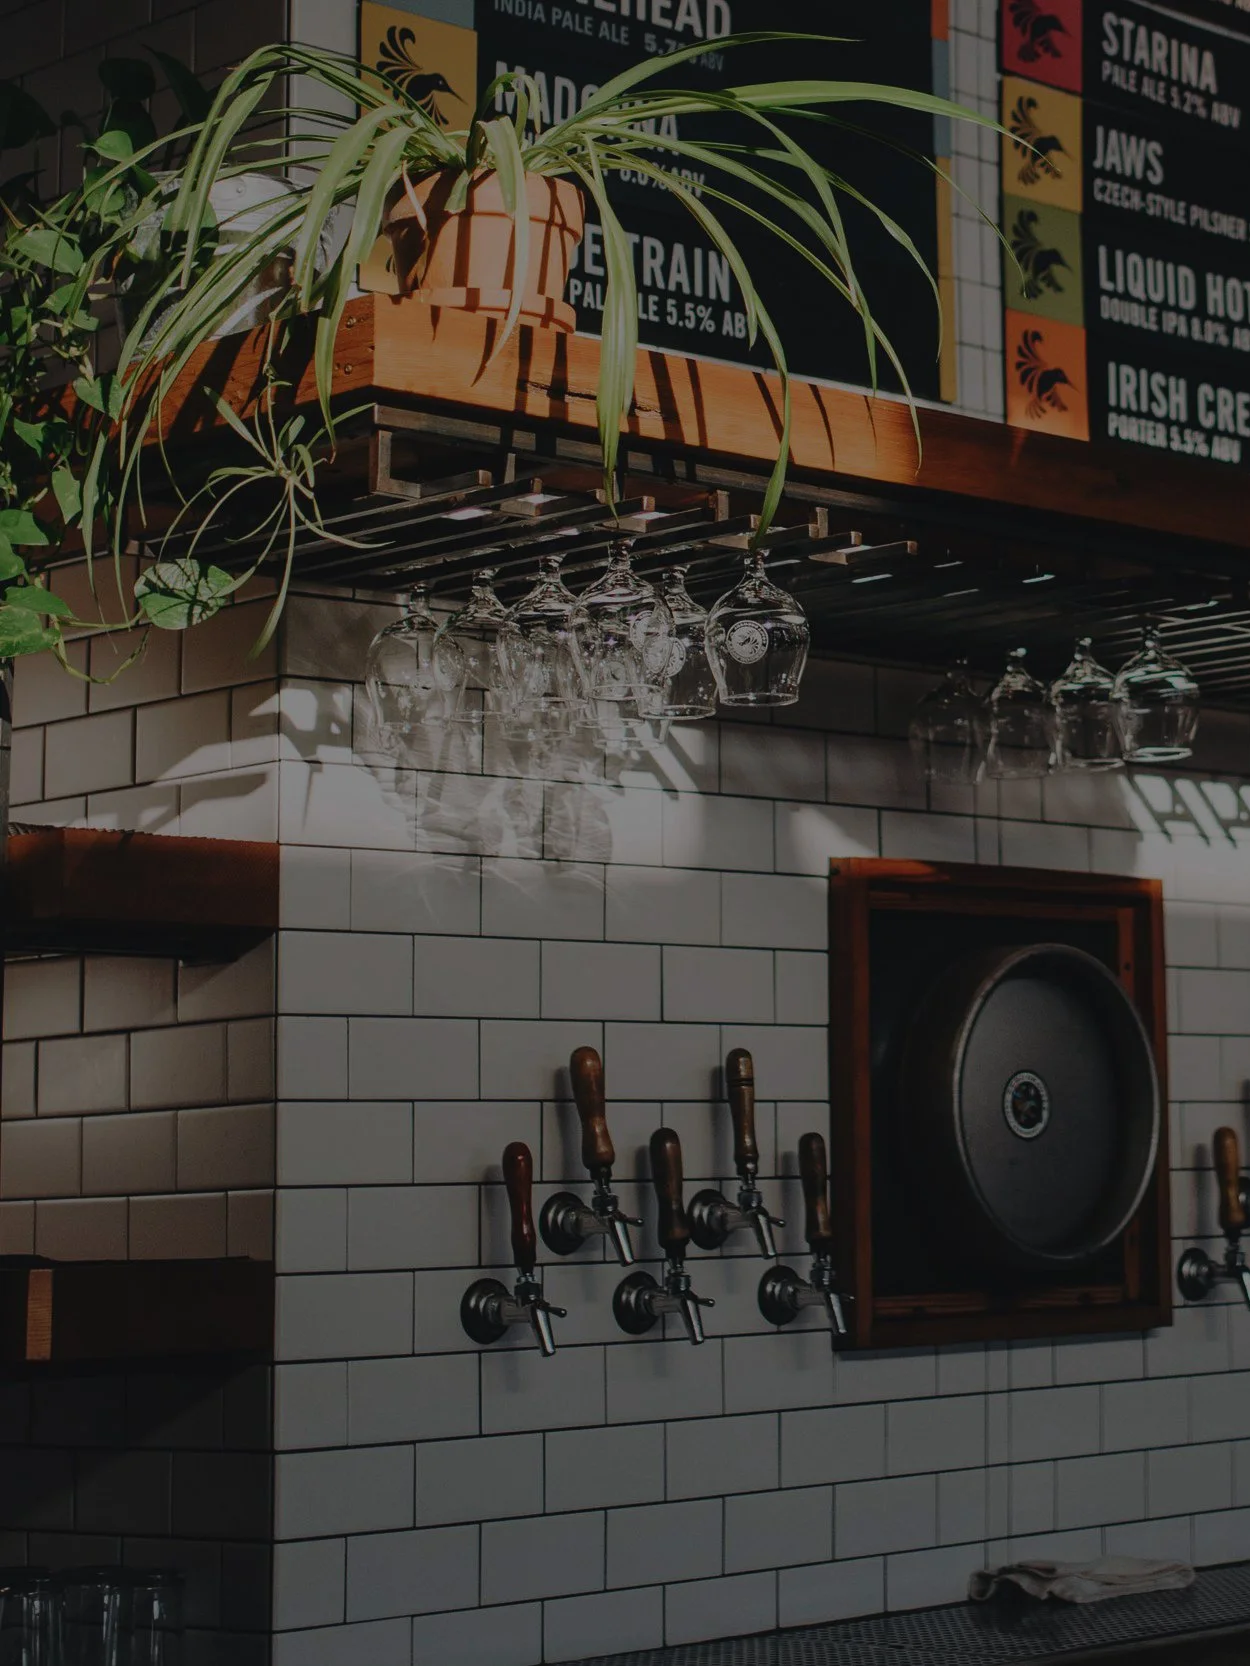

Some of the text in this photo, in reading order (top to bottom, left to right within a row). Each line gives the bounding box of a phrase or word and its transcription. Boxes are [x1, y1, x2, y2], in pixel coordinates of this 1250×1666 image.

[493, 0, 546, 24] INDIA
[551, 6, 593, 36] PALE
[598, 20, 631, 46] ALE
[1101, 11, 1218, 95] STARINA
[1101, 60, 1138, 94] PALE
[1141, 76, 1168, 106] ALE
[1211, 101, 1242, 129] ABV
[1093, 125, 1165, 185] JAWS
[1093, 177, 1188, 226] CZECH-STYLE
[1190, 204, 1248, 242] PILSNER
[570, 278, 605, 311] PAL
[666, 298, 717, 334] 5.5%
[1098, 244, 1197, 310] LIQUID
[1099, 294, 1160, 332] DOUBLE
[1162, 309, 1190, 339] IPA
[1107, 360, 1189, 423] IRISH
[1107, 411, 1168, 450] PORTER
[1211, 435, 1242, 465] ABV
